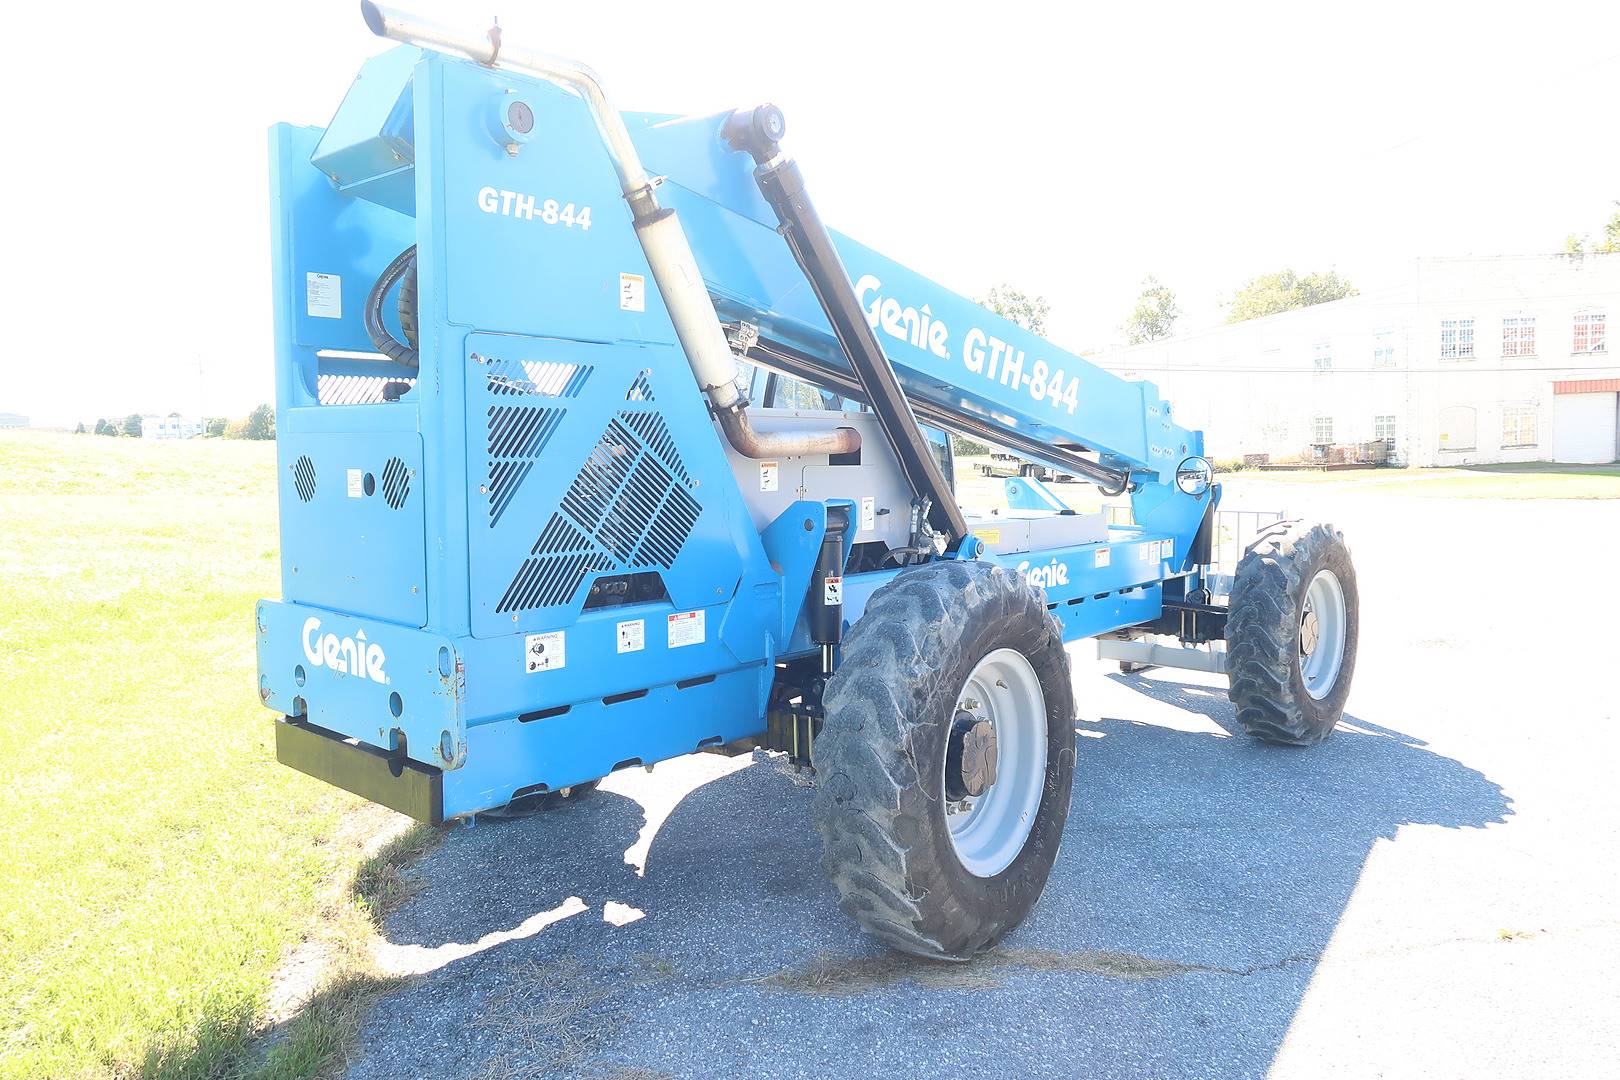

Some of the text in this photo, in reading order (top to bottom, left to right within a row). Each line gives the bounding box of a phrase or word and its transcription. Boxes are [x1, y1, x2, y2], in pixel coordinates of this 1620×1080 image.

[478, 185, 592, 231] GTH-844
[855, 274, 1080, 415] Genie GTH-844
[302, 616, 386, 685] Genie
[537, 633, 558, 641] WARNING
